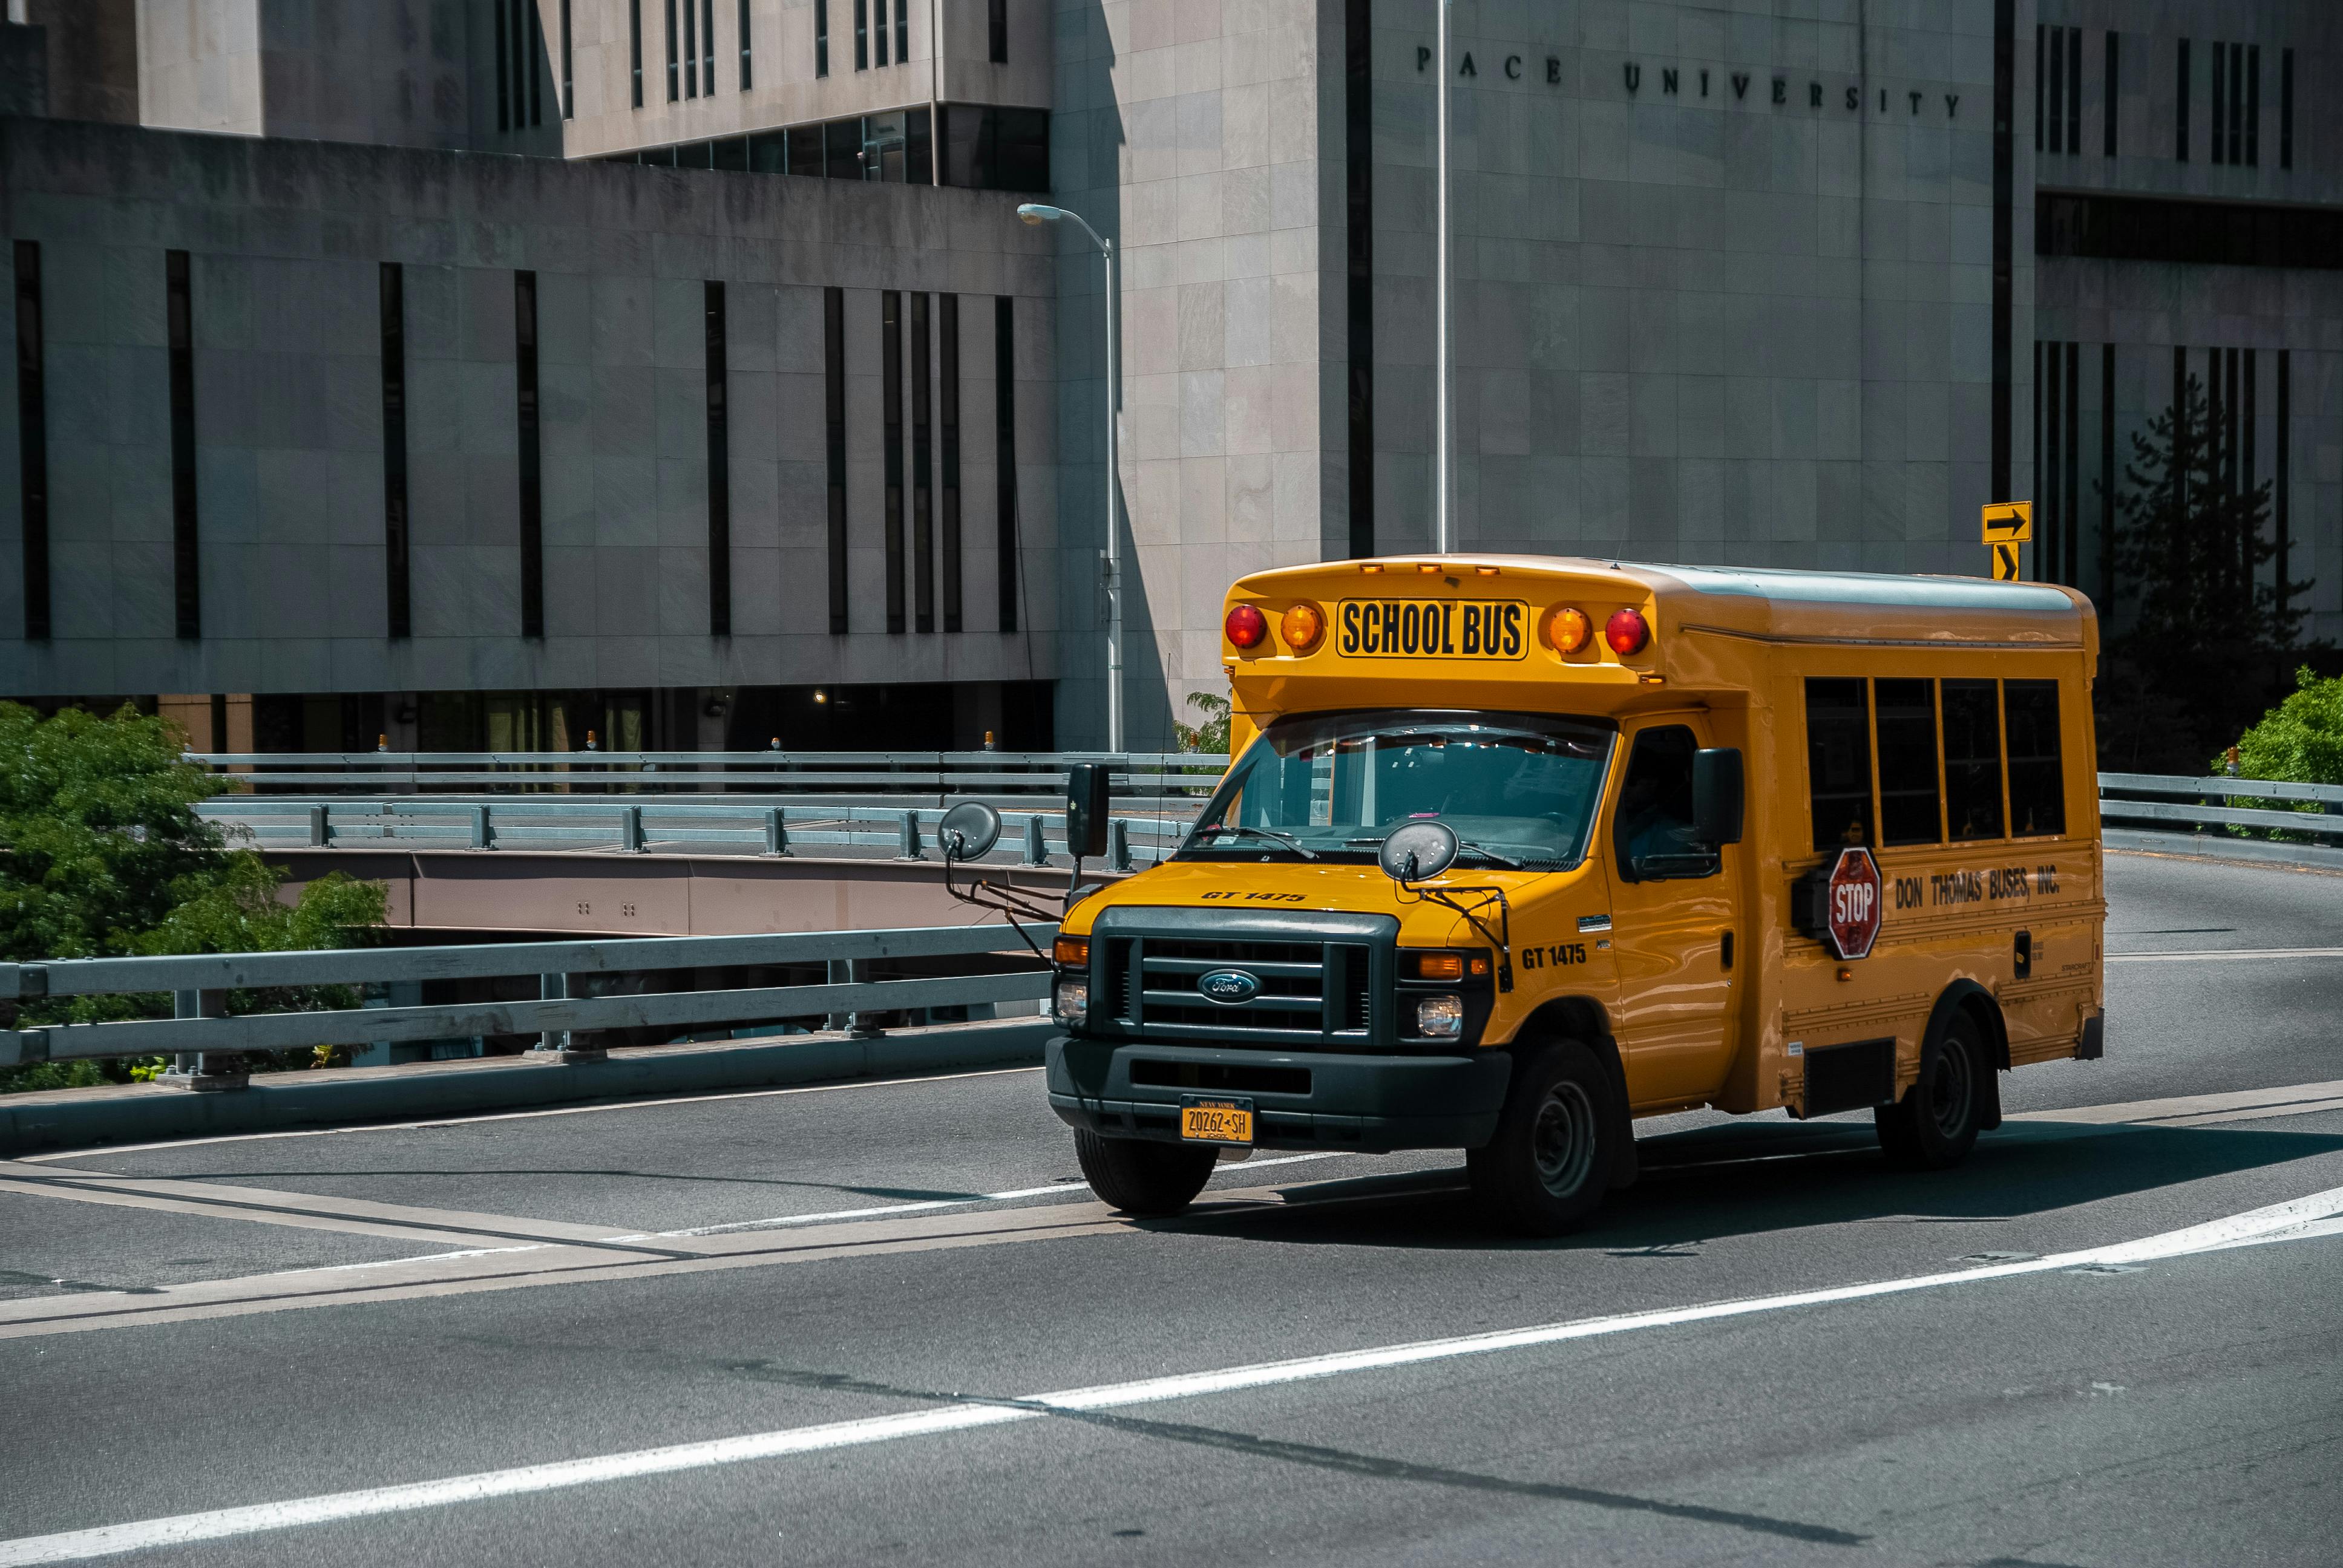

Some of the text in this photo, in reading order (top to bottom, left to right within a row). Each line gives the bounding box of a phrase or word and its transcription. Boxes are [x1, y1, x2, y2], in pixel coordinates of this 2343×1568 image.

[1417, 45, 1959, 118] PACE UNIVERSITY
[1343, 602, 1521, 655] SCHOOL BUS
[1244, 892, 1308, 902] 1475
[1836, 883, 1873, 923] STOP
[1896, 864, 2059, 909] DON THOMAS BUSES, INC.
[1522, 947, 1544, 970] GT
[1548, 942, 1587, 966] 1475
[1212, 978, 1242, 993] Ford
